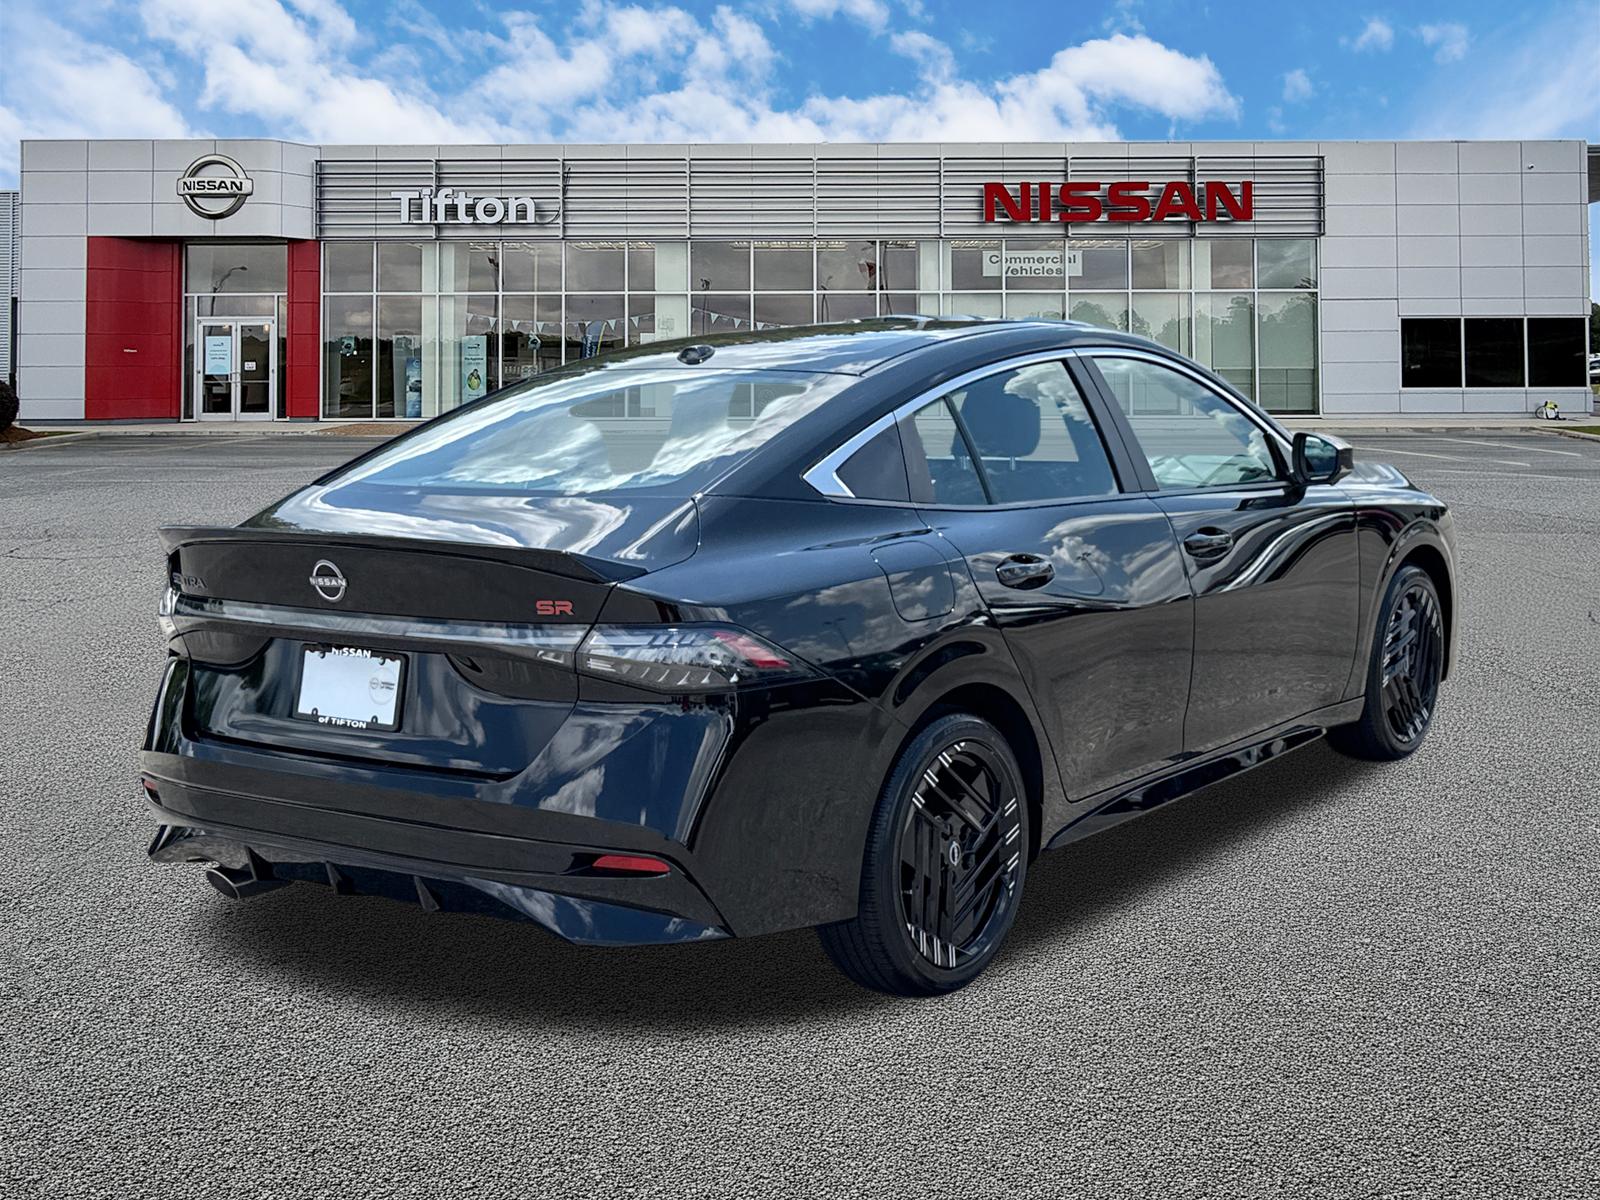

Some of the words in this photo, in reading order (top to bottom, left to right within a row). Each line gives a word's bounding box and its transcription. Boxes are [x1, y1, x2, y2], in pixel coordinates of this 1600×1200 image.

[183, 180, 243, 191] NISSAN
[390, 186, 536, 224] Tifton
[984, 180, 1253, 223] NISSAN
[309, 572, 346, 586] NISSAN
[536, 600, 575, 615] SR
[331, 647, 371, 658] NISSAN
[318, 716, 329, 724] of
[331, 717, 367, 729] TIFTON
